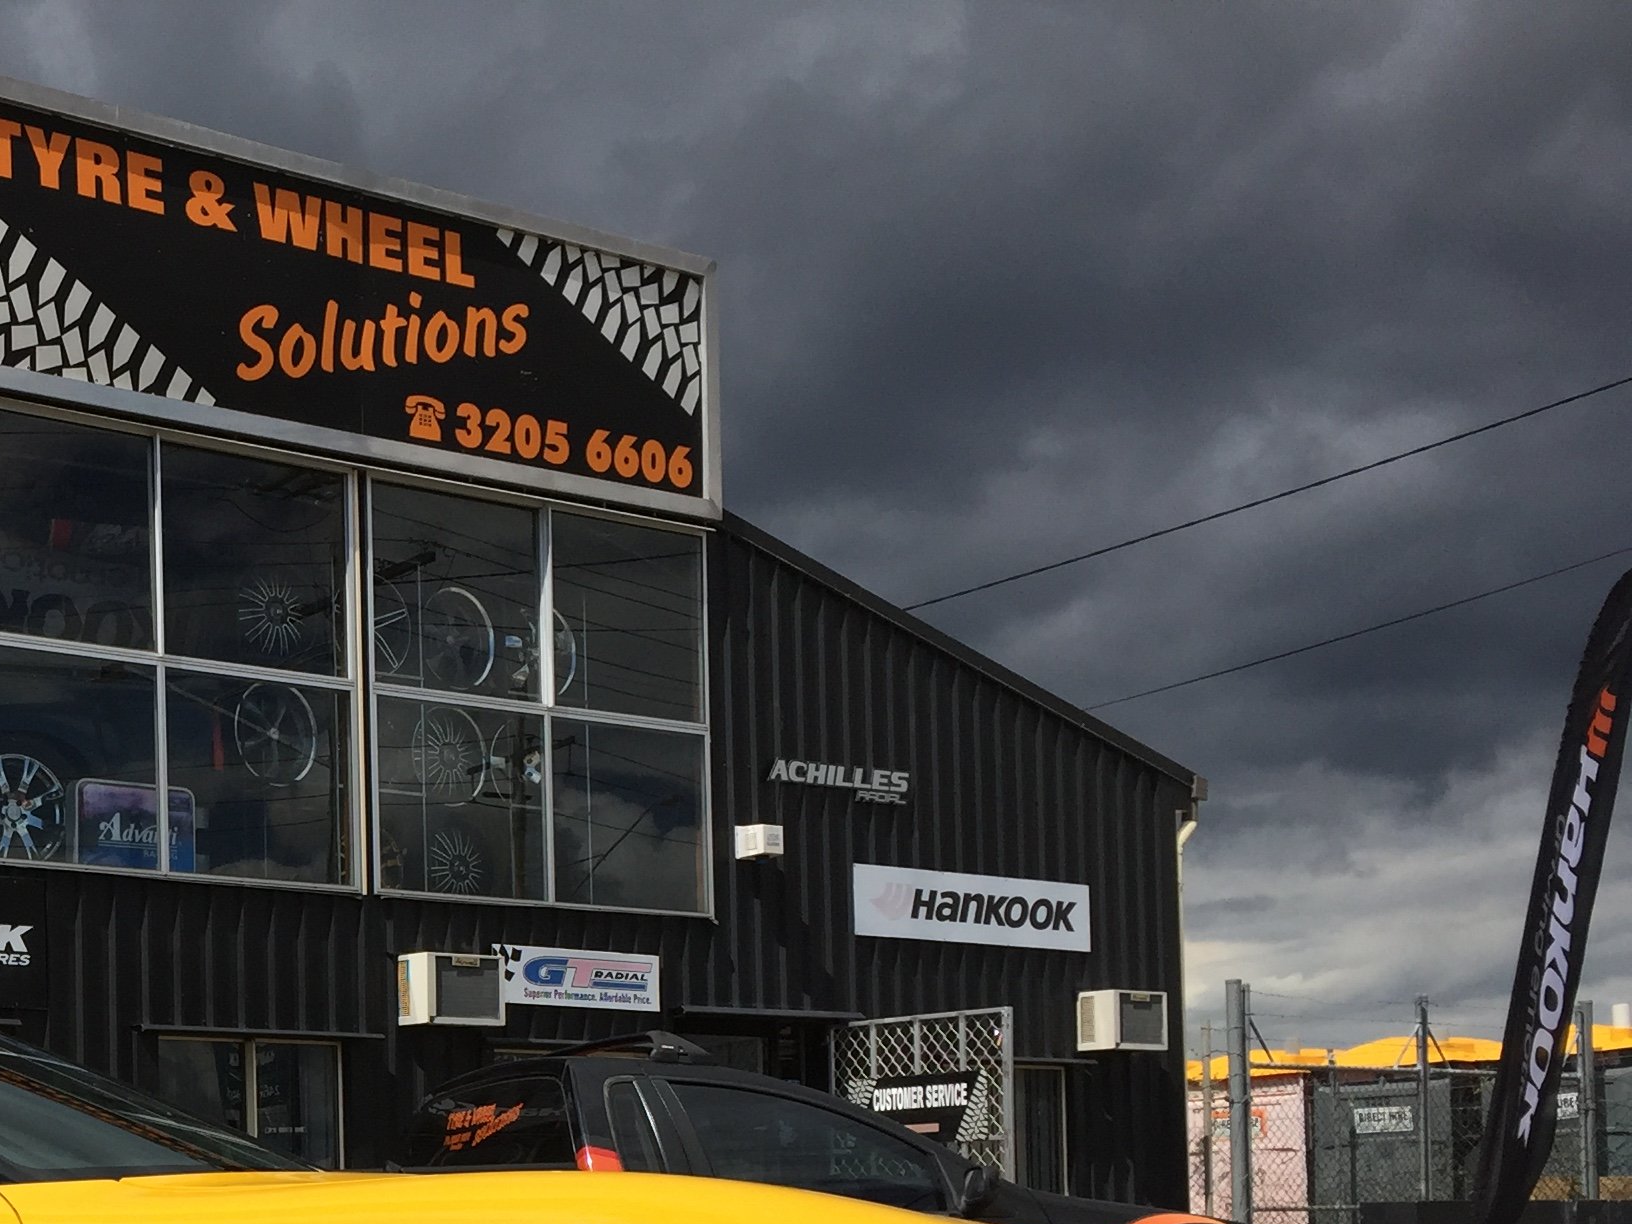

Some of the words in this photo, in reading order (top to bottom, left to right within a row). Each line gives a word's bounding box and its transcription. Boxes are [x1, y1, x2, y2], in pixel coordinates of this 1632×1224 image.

[185, 170, 237, 232] &
[253, 182, 475, 289] WHEEL
[236, 292, 530, 382] Solutions
[454, 402, 570, 465] 3205
[585, 430, 694, 490] 6606
[769, 758, 910, 792] ACHILLES
[522, 955, 653, 989] GT
[593, 971, 649, 982] RADIAL
[873, 1086, 924, 1112] CUSTOMER
[925, 1082, 968, 1108] SERVICE
